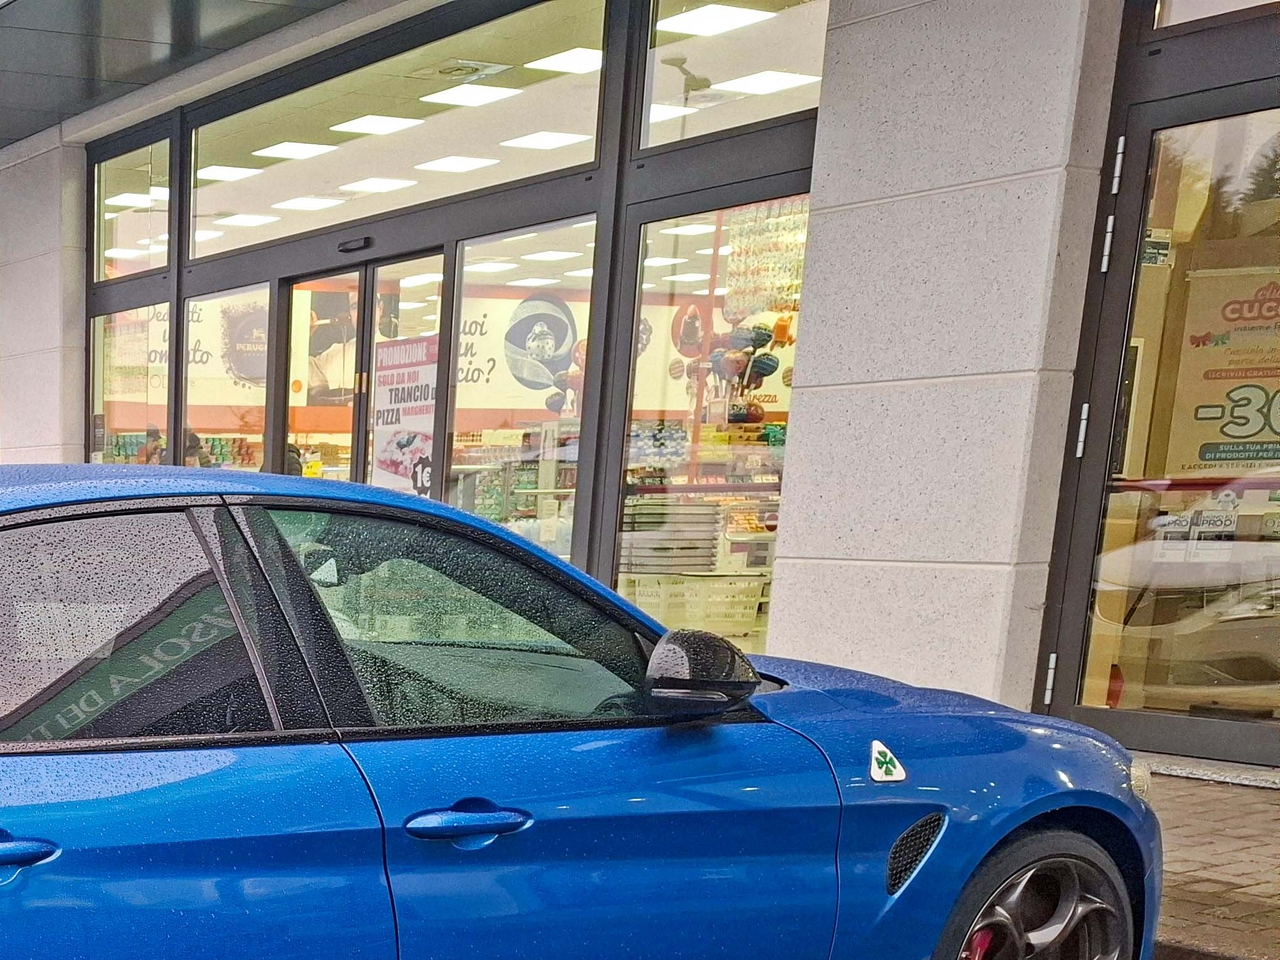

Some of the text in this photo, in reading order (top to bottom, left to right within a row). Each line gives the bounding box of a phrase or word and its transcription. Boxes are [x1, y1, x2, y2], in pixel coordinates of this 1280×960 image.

[1225, 301, 1280, 319] CUC
[377, 341, 427, 367] PROMOZIONE
[377, 370, 419, 387] SOLO DA NOI
[388, 384, 430, 405] TRANCIO
[376, 408, 401, 426] PIZZA
[1216, 451, 1256, 459] PRODOTTI
[414, 463, 431, 488] 1€
